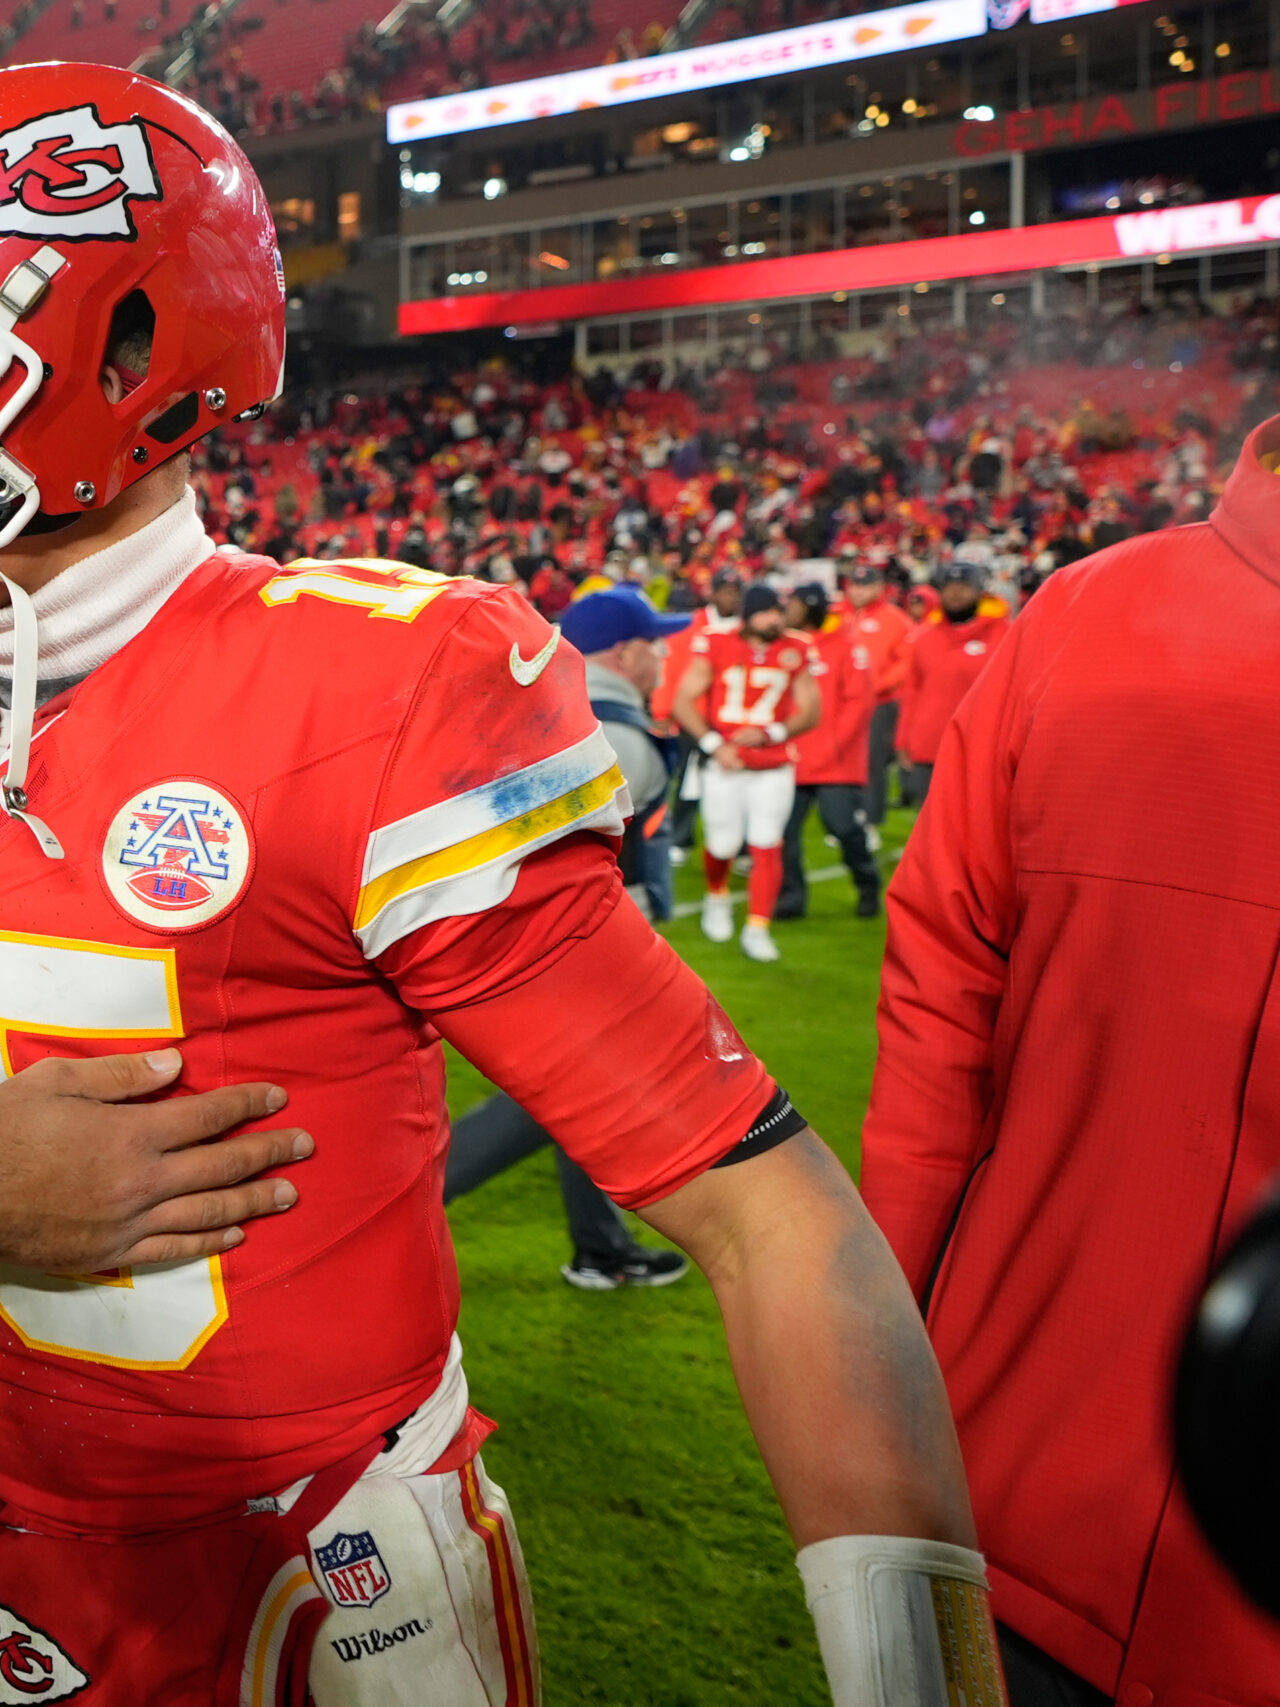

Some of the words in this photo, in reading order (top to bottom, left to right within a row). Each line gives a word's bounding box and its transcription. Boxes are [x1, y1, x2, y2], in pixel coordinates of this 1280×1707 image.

[953, 96, 1135, 156] GEHA
[717, 664, 790, 725] 17
[153, 877, 187, 898] LH
[328, 1560, 386, 1602] NFL
[330, 1617, 425, 1663] Wilson
